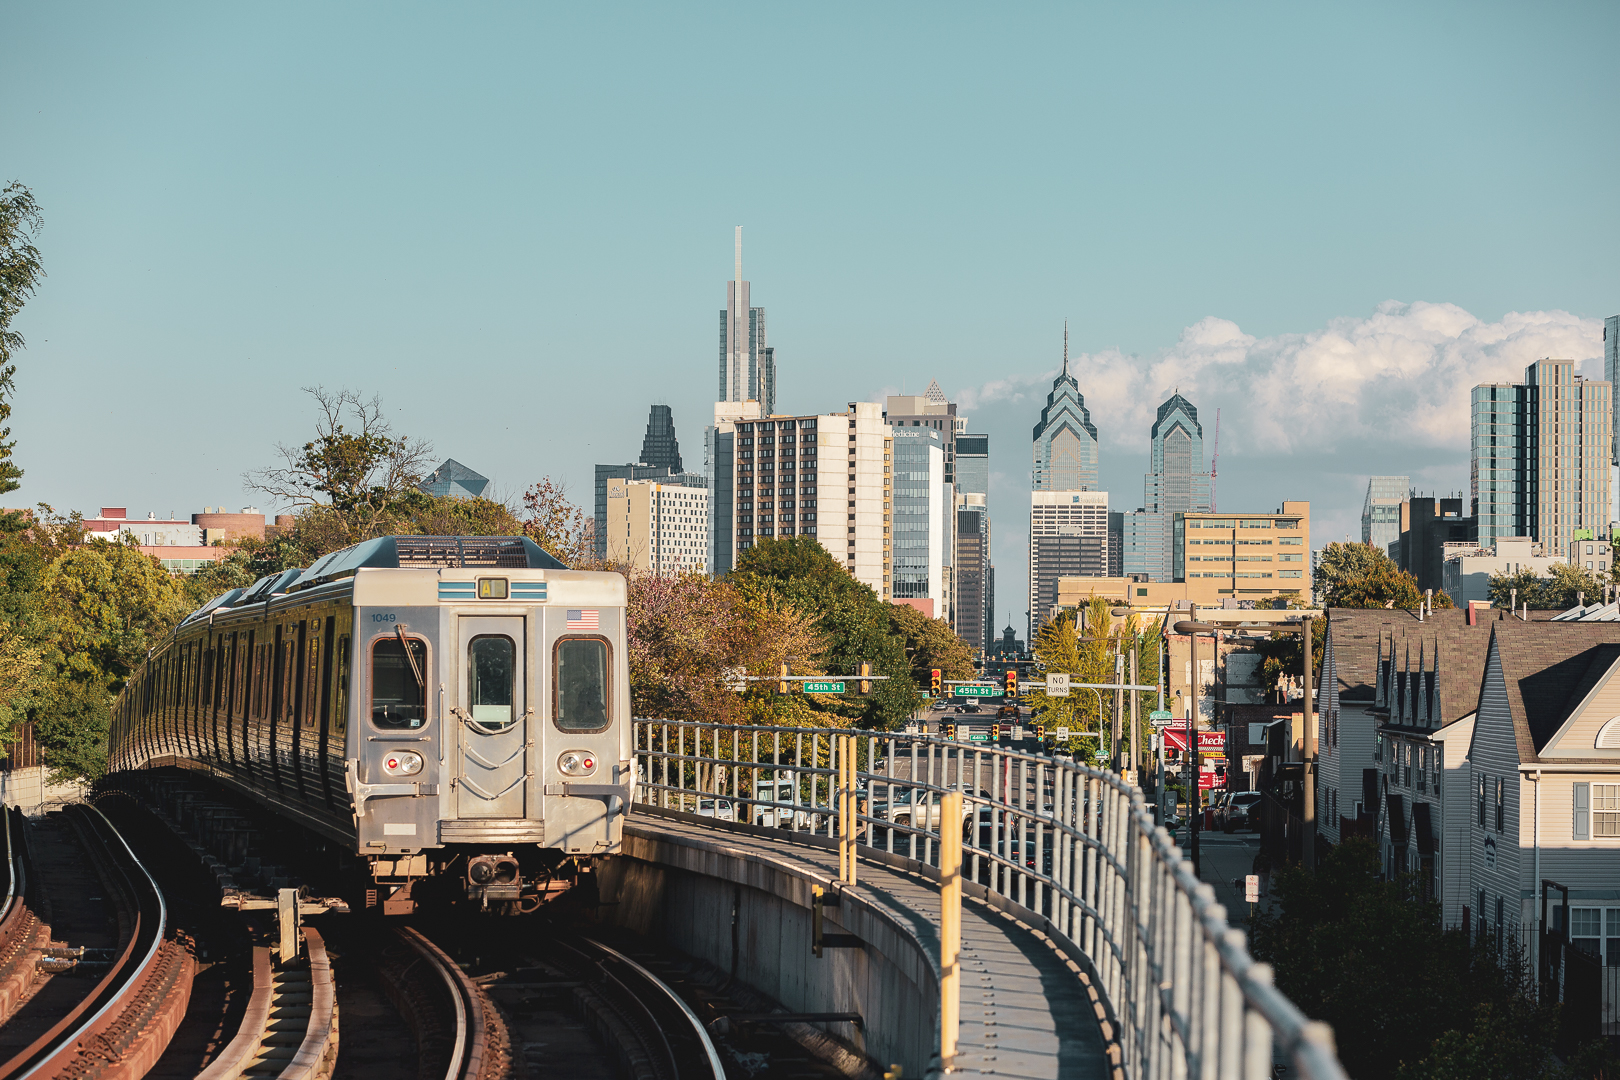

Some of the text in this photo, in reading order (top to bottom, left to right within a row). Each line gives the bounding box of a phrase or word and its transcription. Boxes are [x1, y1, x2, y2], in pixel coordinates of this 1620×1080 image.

[482, 580, 491, 597] A
[371, 613, 396, 623] 1049
[1053, 676, 1064, 684] NO
[808, 683, 841, 691] 45th St
[958, 687, 978, 695] 45th
[980, 687, 989, 695] St
[1198, 735, 1225, 745] Check
